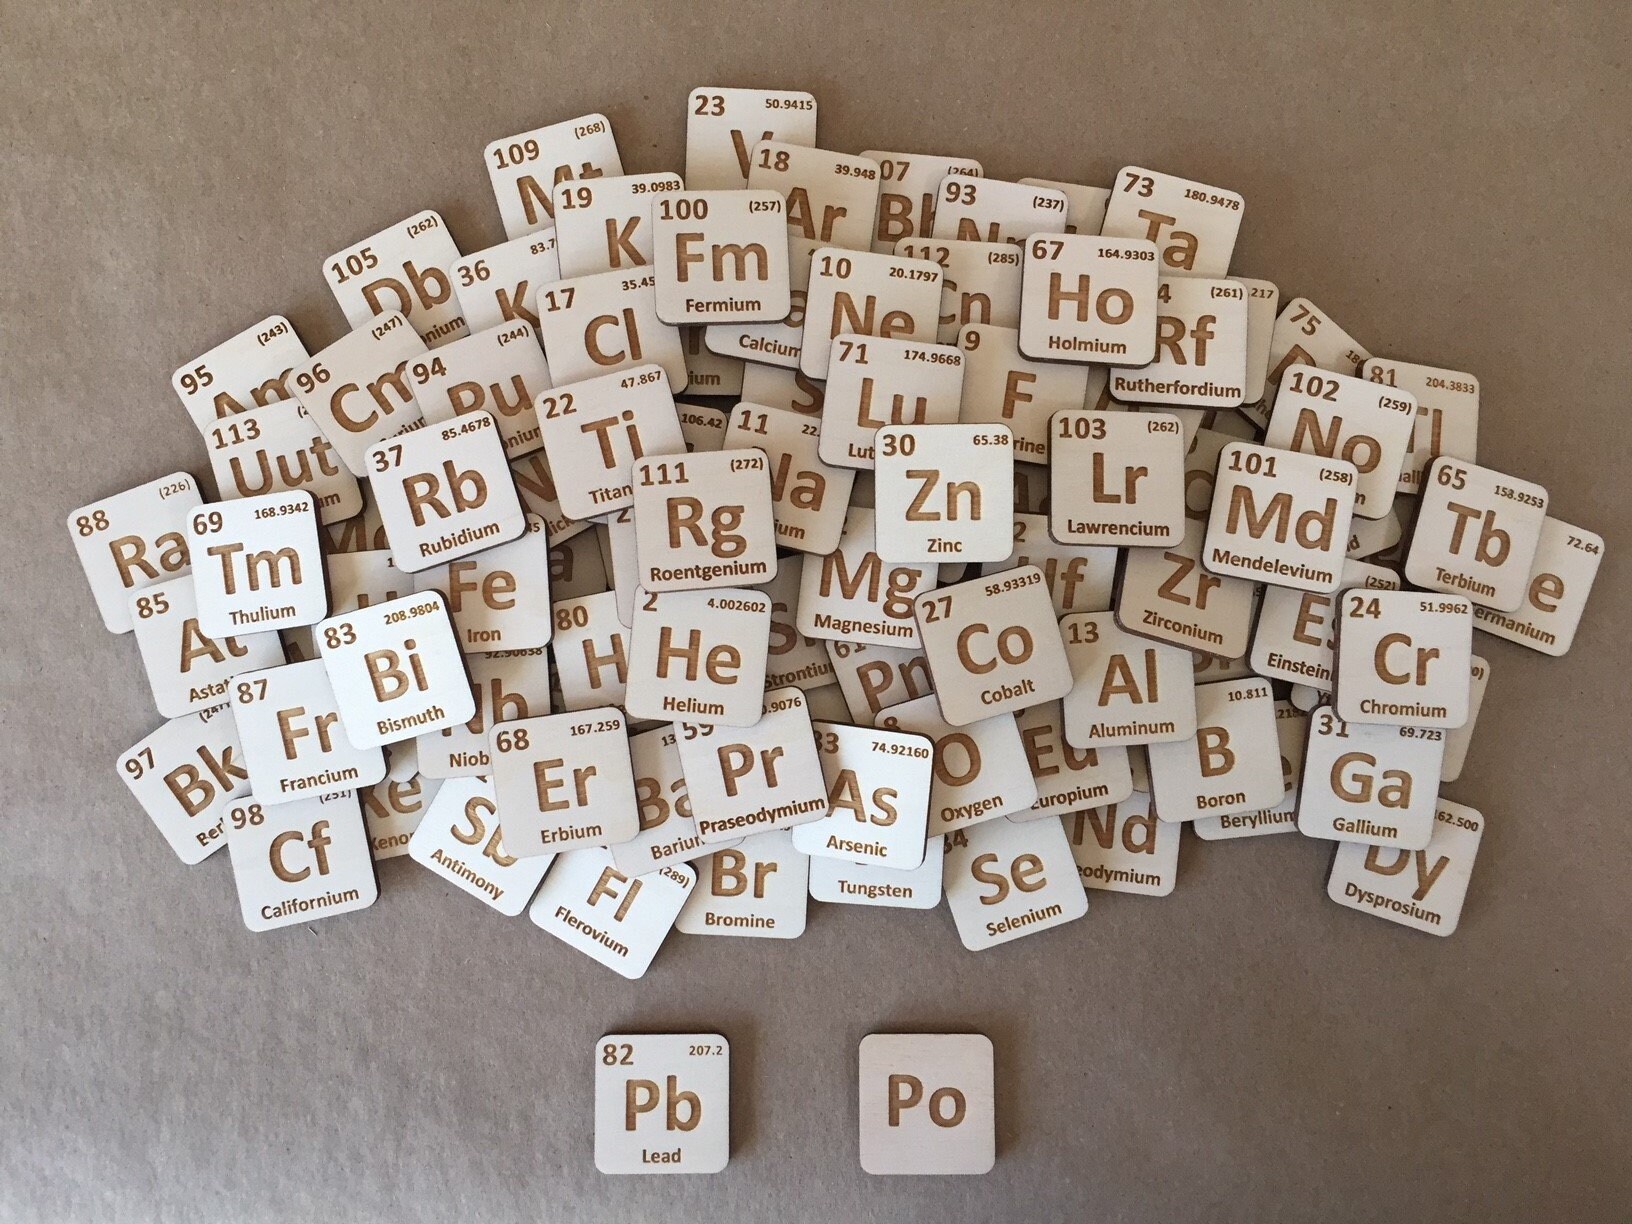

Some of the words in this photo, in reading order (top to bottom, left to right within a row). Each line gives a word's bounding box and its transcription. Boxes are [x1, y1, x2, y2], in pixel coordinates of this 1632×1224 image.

[694, 96, 725, 116] 23
[765, 99, 812, 111] 50.9415
[574, 121, 605, 139] (268)
[493, 139, 540, 170] 109
[759, 149, 790, 172] 18
[834, 164, 875, 179] 39.948
[632, 180, 680, 194] 39.0983
[945, 182, 977, 205] 93
[1123, 172, 1154, 198] 73
[562, 187, 592, 210] 19
[659, 199, 708, 221] 100
[749, 200, 781, 214] (257)
[1032, 196, 1064, 212] (237)
[1184, 188, 1240, 211] 180.9478
[407, 215, 438, 238] (262)
[606, 216, 646, 268] K
[1032, 240, 1064, 261] 67
[1098, 248, 1154, 261] 164.9303
[331, 247, 378, 283] 105
[675, 232, 768, 282] Fm
[820, 257, 851, 278] 10
[988, 252, 1019, 266] (285)
[457, 260, 490, 287] 36
[889, 267, 938, 282] 20.1797
[545, 288, 575, 312] 17
[686, 297, 761, 313] Fermium
[1048, 272, 1134, 325] Ho
[1211, 286, 1243, 301] (261)
[372, 315, 403, 340] (247)
[830, 291, 915, 339] Ne
[1289, 304, 1322, 336] 75
[257, 321, 288, 346] (243)
[498, 326, 529, 346] (244)
[584, 308, 642, 366] Cl
[965, 331, 980, 351] 9
[1048, 336, 1127, 355] Holmium
[838, 341, 869, 364] 71
[904, 350, 961, 366] 174.9668
[180, 364, 213, 395] 95
[297, 362, 331, 394] 96
[412, 357, 447, 384] 94
[620, 371, 662, 390] 47.867
[1001, 370, 1036, 419] F
[1114, 377, 1241, 398] Rutherfordium
[1289, 372, 1340, 402] 102
[1426, 377, 1475, 394] 204.3833
[543, 393, 577, 419] 22
[858, 378, 927, 429] Lu
[1378, 396, 1412, 414] (259)
[212, 418, 261, 449] 113
[441, 417, 491, 440] 85.4678
[681, 413, 722, 429] 106.42
[738, 409, 768, 435] 11
[1059, 417, 1106, 440] 103
[1148, 421, 1179, 434] (262)
[580, 409, 644, 469] Ti
[882, 434, 916, 456] 30
[973, 434, 1008, 446] 65.38
[229, 436, 338, 498] Uut
[372, 444, 403, 472] 37
[730, 458, 763, 472] (272)
[1228, 451, 1277, 478] 101
[639, 462, 689, 487] 111
[1092, 452, 1148, 504] Lr
[1319, 468, 1352, 485] (258)
[1437, 465, 1467, 489] 65
[159, 479, 190, 499] (226)
[402, 460, 488, 528] Rb
[906, 469, 981, 521] Zn
[1494, 485, 1544, 508] 158.9253
[76, 510, 110, 537] 88
[193, 512, 223, 535] 69
[254, 502, 309, 520] 168.9342
[1226, 484, 1338, 552] Md
[419, 521, 500, 558] Rubidium
[666, 496, 746, 558] Rg
[1067, 520, 1169, 537] Lawrencium
[1447, 502, 1511, 567] Tb
[928, 538, 962, 553] Zinc
[1567, 535, 1599, 554] 72.64
[109, 531, 189, 588] Ra
[207, 542, 302, 594] Tm
[651, 561, 767, 581] Roentgenium
[1212, 548, 1333, 584] Mendelevium
[985, 572, 1041, 597] 58.93319
[1158, 552, 1221, 610] Zr
[1436, 568, 1496, 597] Terbium
[136, 592, 169, 619] 85
[229, 604, 296, 626] Thulium
[384, 601, 440, 625] 208.9804
[707, 598, 766, 612] 4.002602
[922, 596, 952, 623] 27
[1350, 596, 1381, 619] 24
[1419, 601, 1468, 615] 51.9962
[556, 605, 588, 631] 80
[814, 614, 913, 638] Magnesium
[1142, 609, 1223, 644] Zirconium
[324, 622, 357, 649] 83
[467, 628, 502, 643] Iron
[1068, 622, 1099, 644] 13
[656, 627, 741, 685] He
[956, 622, 1034, 675] Co
[1374, 632, 1439, 686] Cr
[363, 638, 429, 702] Bi
[1098, 649, 1159, 707] Al
[237, 678, 268, 704] 87
[981, 679, 1035, 706] Cobalt
[1228, 687, 1268, 701] 10.811
[663, 697, 724, 715] Helium
[1360, 699, 1447, 718] Chromium
[277, 706, 338, 760] Fr
[377, 706, 445, 735] Bismuth
[570, 720, 620, 737] 167.259
[1089, 720, 1174, 739] Aluminum
[496, 728, 529, 753] 68
[1399, 727, 1442, 741] 69.723
[871, 742, 929, 759] 74.92160
[126, 747, 155, 780] 97
[717, 743, 784, 797] Pr
[163, 744, 248, 818] Bk
[280, 767, 358, 793] Francium
[533, 758, 597, 812] Er
[1329, 752, 1412, 809] Ga
[828, 769, 897, 827] As
[941, 794, 1003, 823] Oxygen
[1197, 791, 1246, 810] Boron
[231, 803, 264, 829] 98
[700, 798, 825, 835] Praseodymium
[1332, 817, 1397, 839] Gallium
[541, 824, 602, 844] Erbium
[827, 835, 888, 857] Arsenic
[269, 820, 332, 883] Cf
[431, 849, 504, 900] Antimony
[711, 849, 777, 898] Br
[971, 853, 1047, 906] Se
[587, 866, 643, 922] Fl
[838, 880, 912, 898] Tungsten
[261, 888, 359, 920] Californium
[1344, 882, 1441, 924] Dysprosium
[555, 906, 629, 957] Flerovium
[705, 912, 775, 929] Bromine
[986, 903, 1062, 936] Selenium
[602, 1044, 634, 1065] 82
[689, 1046, 722, 1056] 207.2
[625, 1075, 702, 1131] Pb
[888, 1074, 966, 1128] Po
[642, 1148, 681, 1163] Lead
